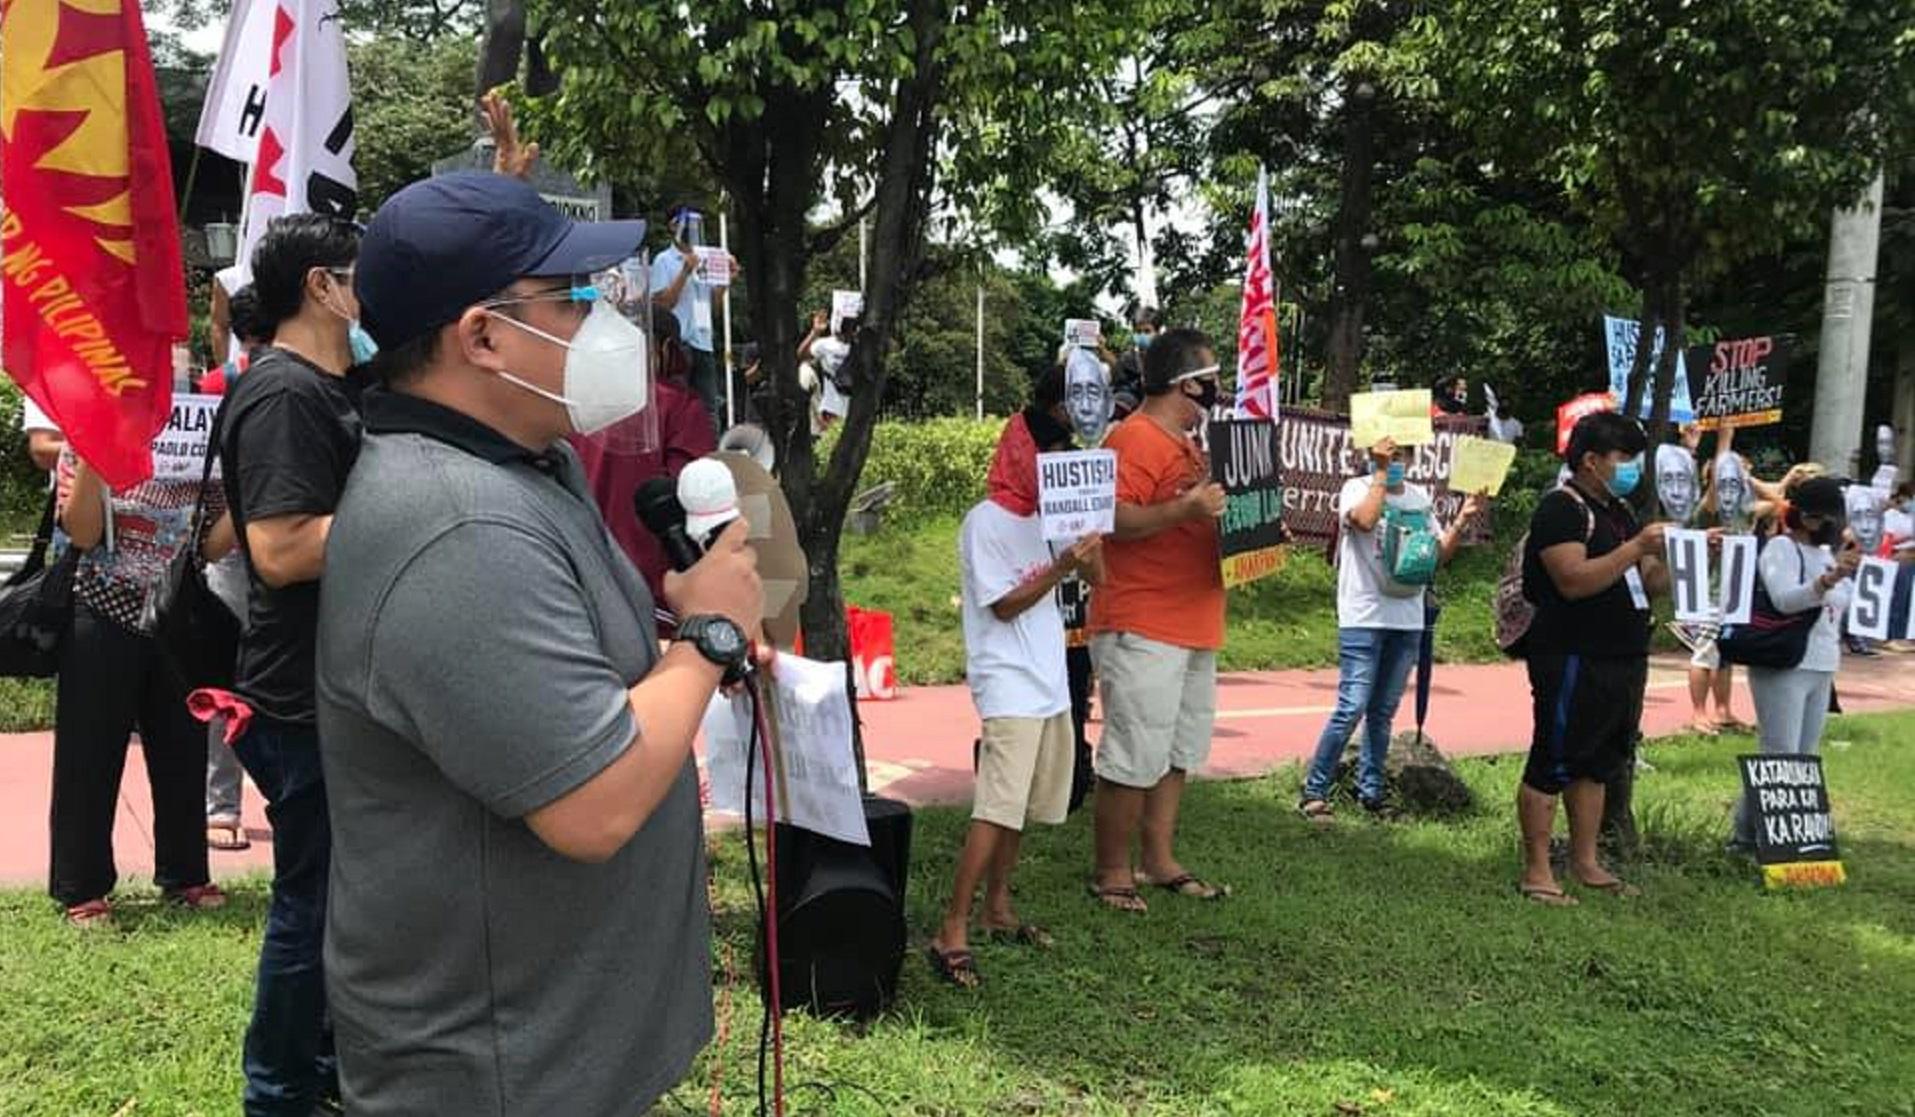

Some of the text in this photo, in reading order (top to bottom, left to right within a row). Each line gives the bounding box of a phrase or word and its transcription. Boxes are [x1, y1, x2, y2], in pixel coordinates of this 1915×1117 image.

[28, 274, 147, 396] PILIPINAS
[1711, 336, 1772, 373] STOP
[1704, 366, 1767, 396] KILLING
[1693, 385, 1783, 418] FARMERS!
[1225, 424, 1272, 487] JUNK
[1281, 420, 1355, 475] UNITE
[1856, 563, 1884, 628] S
[1760, 788, 1799, 812] PARA
[1764, 815, 1793, 845] KA
